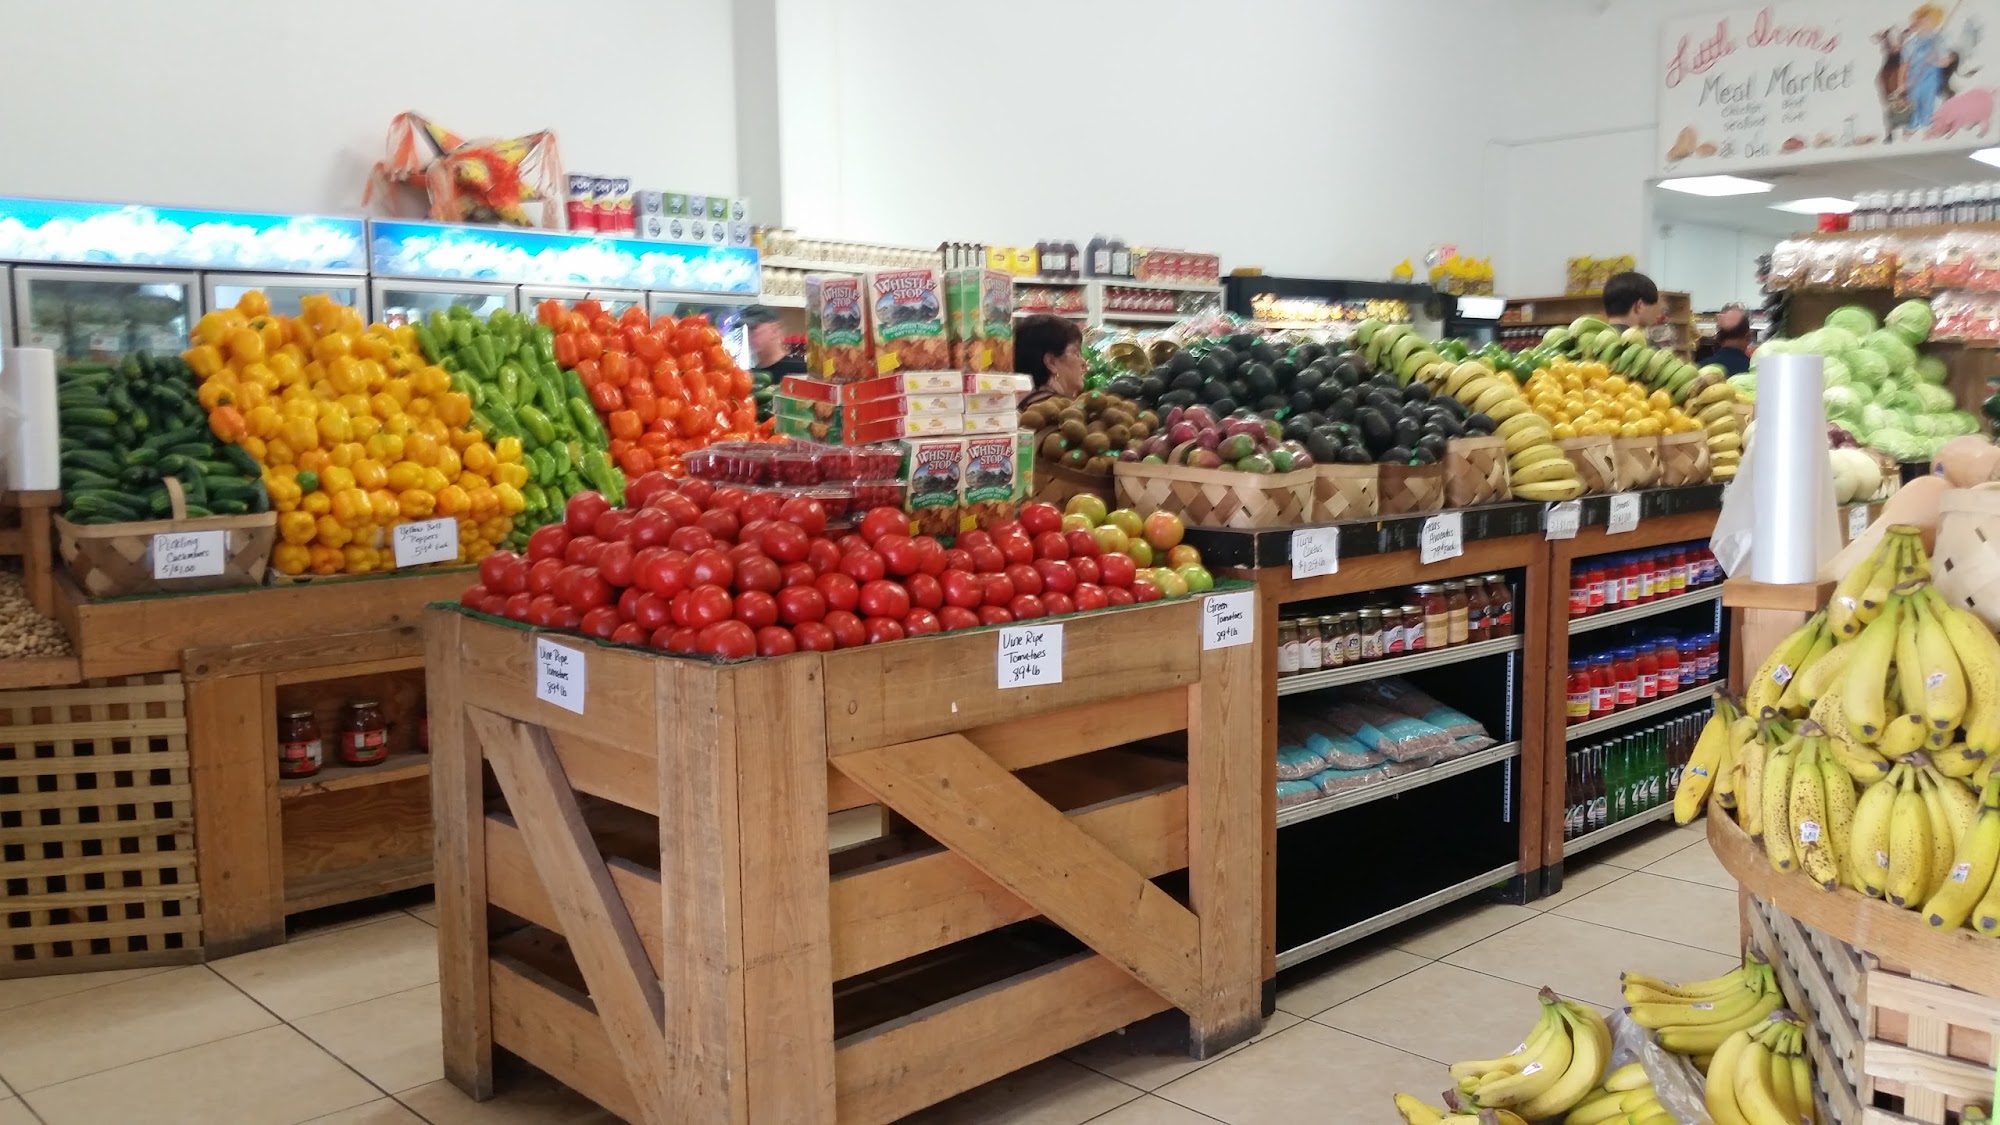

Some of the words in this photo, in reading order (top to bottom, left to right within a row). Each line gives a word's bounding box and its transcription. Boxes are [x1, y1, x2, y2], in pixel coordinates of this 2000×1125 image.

[1765, 59, 1854, 97] Market
[874, 277, 936, 294] WHISTLE
[823, 287, 860, 301] WHISTLE
[893, 288, 922, 299] STOP
[832, 297, 851, 308] STOP
[916, 450, 962, 464] WHISTLE
[966, 444, 1013, 458] WHISTLE
[929, 460, 951, 470] STOP
[980, 455, 1003, 464] STOP
[399, 525, 423, 541] Yellow
[427, 523, 441, 532] Bell
[407, 533, 438, 543] Peppers
[1207, 597, 1227, 613] Green
[1212, 611, 1242, 625] Tomatoes
[1003, 633, 1022, 649] Vine
[1025, 630, 1043, 646] Ripe
[540, 646, 552, 660] Vine
[553, 649, 568, 666] Ripe
[1003, 649, 1046, 663] Tomatoes
[543, 662, 568, 681] Tomatoes
